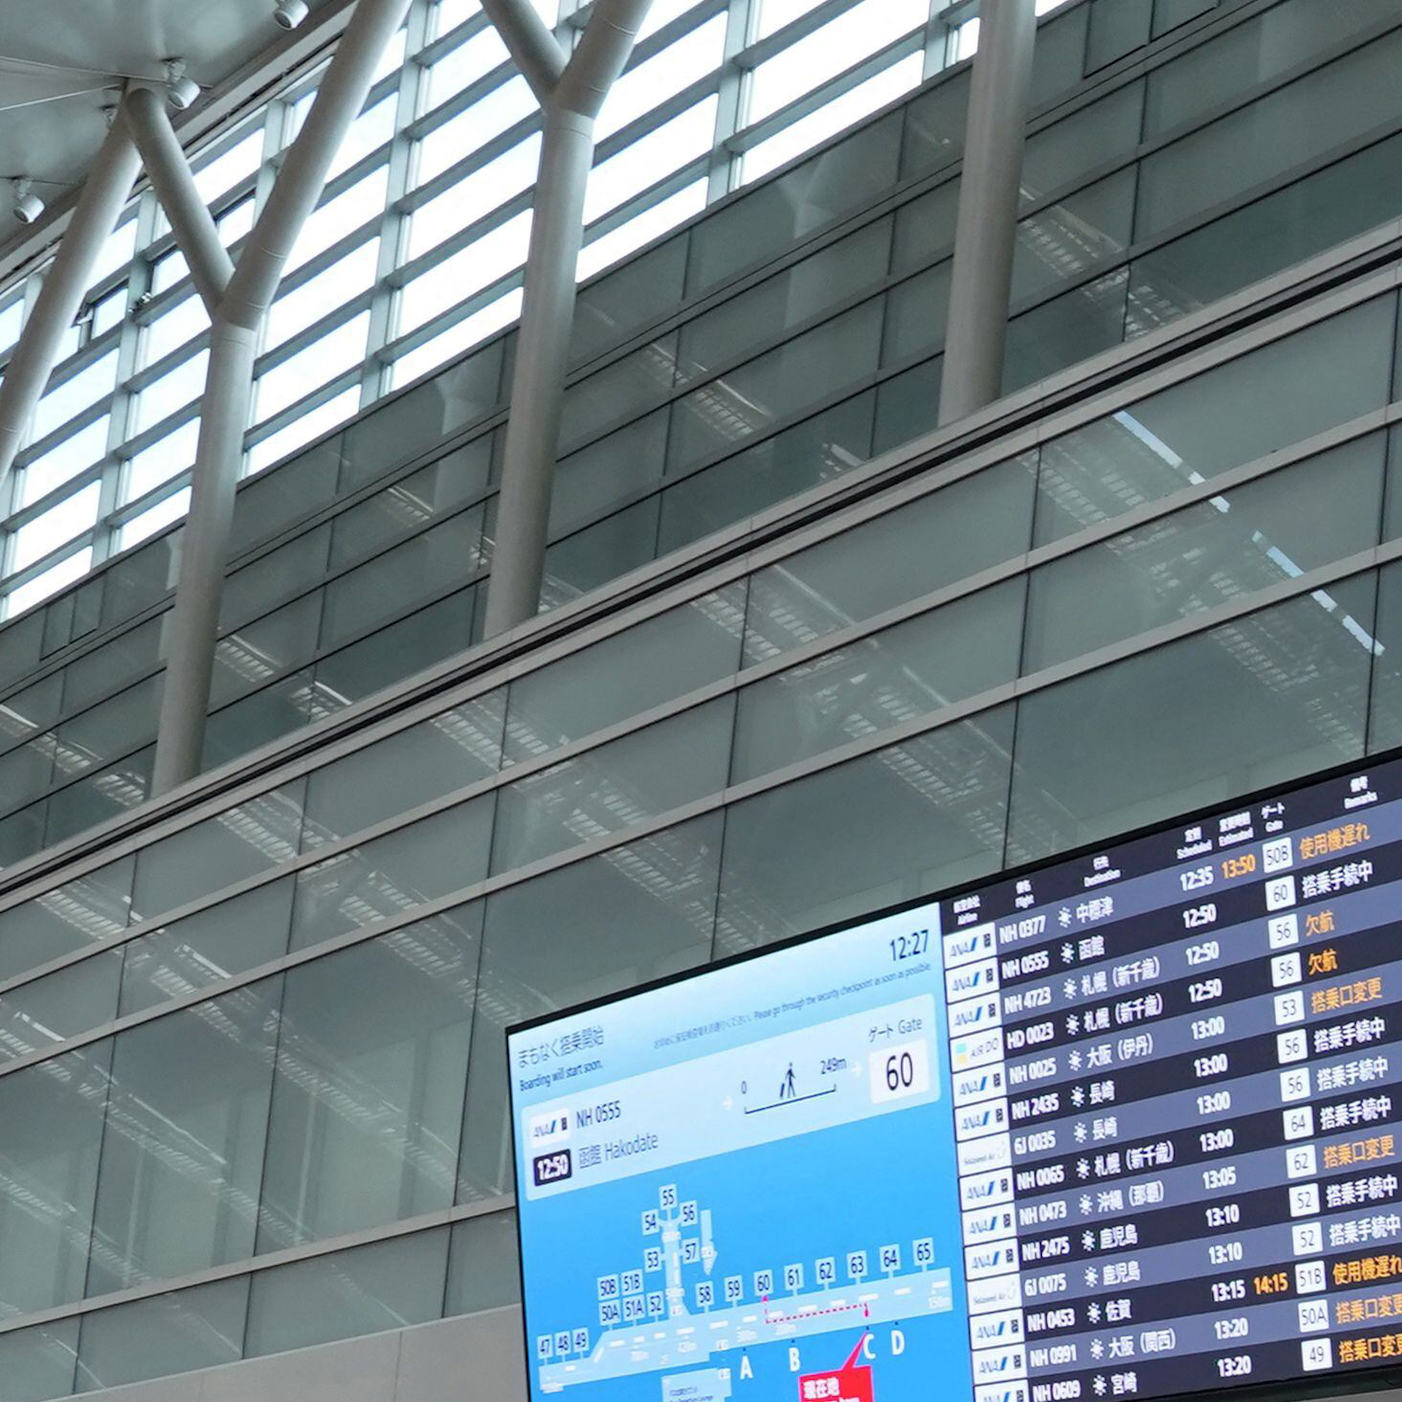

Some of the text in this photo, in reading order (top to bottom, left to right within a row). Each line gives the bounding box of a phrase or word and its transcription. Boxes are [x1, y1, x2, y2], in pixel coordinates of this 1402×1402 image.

[1183, 903, 1217, 928] 12:50
[889, 929, 930, 963] 12:27
[1001, 961, 1020, 980] NH
[1311, 977, 1383, 1015] 搭乗口変更
[898, 1016, 923, 1035] Gate
[1191, 1016, 1225, 1040] 13:00
[885, 1051, 914, 1092] 60
[1009, 1066, 1027, 1085] NH
[576, 1108, 594, 1129] NH
[604, 1133, 659, 1161] Hakodate
[1323, 1134, 1396, 1169] 搭乗口変更
[536, 1153, 569, 1181] 12:50
[1203, 1166, 1237, 1190] 13:05
[661, 1188, 675, 1206] 55
[682, 1204, 696, 1222] 56
[1019, 1207, 1038, 1226] NH
[882, 1249, 898, 1267] 64
[916, 1242, 931, 1261] 65
[818, 1262, 833, 1279] 62
[850, 1255, 865, 1274] 63
[756, 1274, 771, 1292] 60
[787, 1268, 801, 1286] 61
[1253, 1272, 1289, 1295] 14:15
[698, 1286, 712, 1304] 58
[727, 1279, 741, 1297] 59
[1211, 1279, 1246, 1302] 13:15
[1027, 1314, 1046, 1333] NH
[862, 1333, 876, 1360] C
[891, 1330, 905, 1355] D
[739, 1355, 754, 1380] A
[788, 1347, 801, 1372] B
